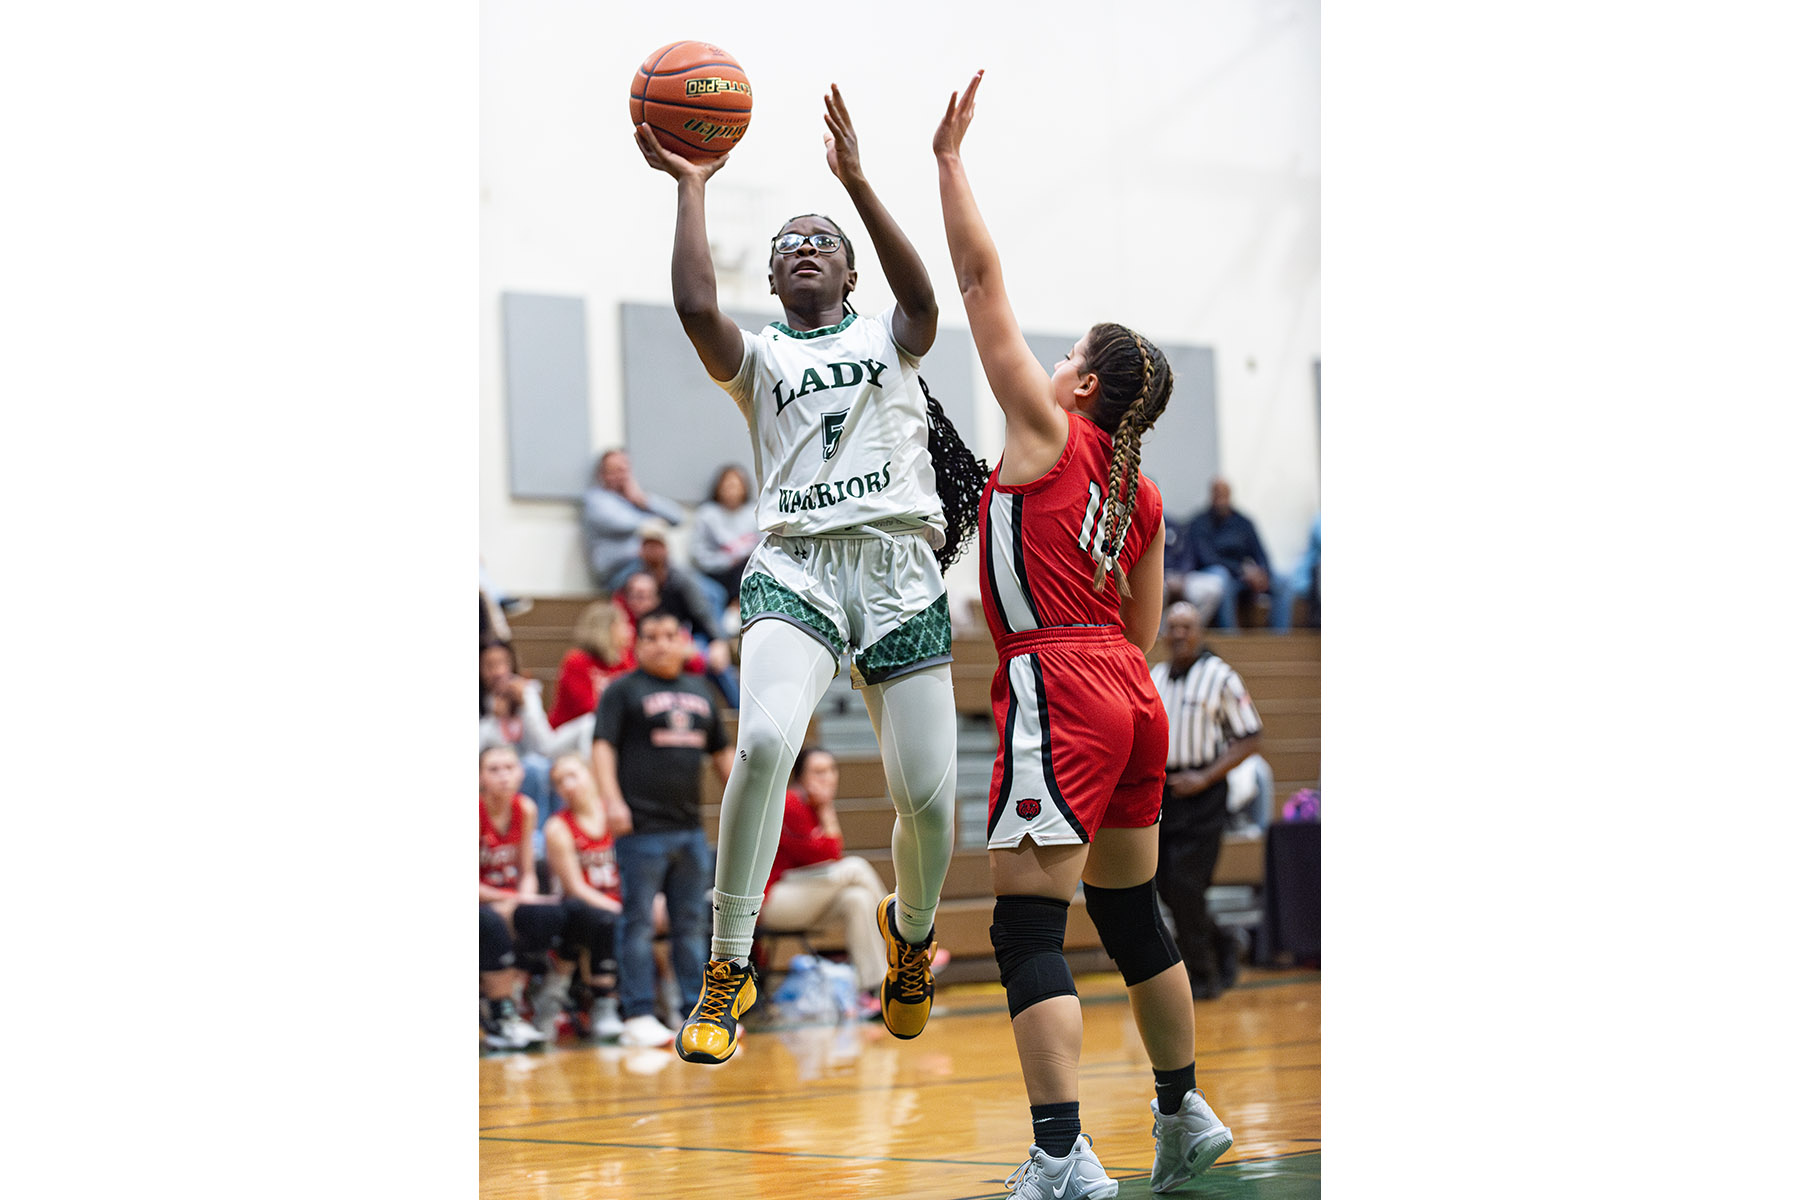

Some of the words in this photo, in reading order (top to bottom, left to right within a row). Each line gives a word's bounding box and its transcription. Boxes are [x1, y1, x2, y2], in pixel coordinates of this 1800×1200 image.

[687, 78, 718, 94] PRO
[717, 79, 752, 97] LITE
[772, 358, 888, 416] LADY
[820, 407, 851, 462] 5
[779, 461, 891, 514] WARRIORS
